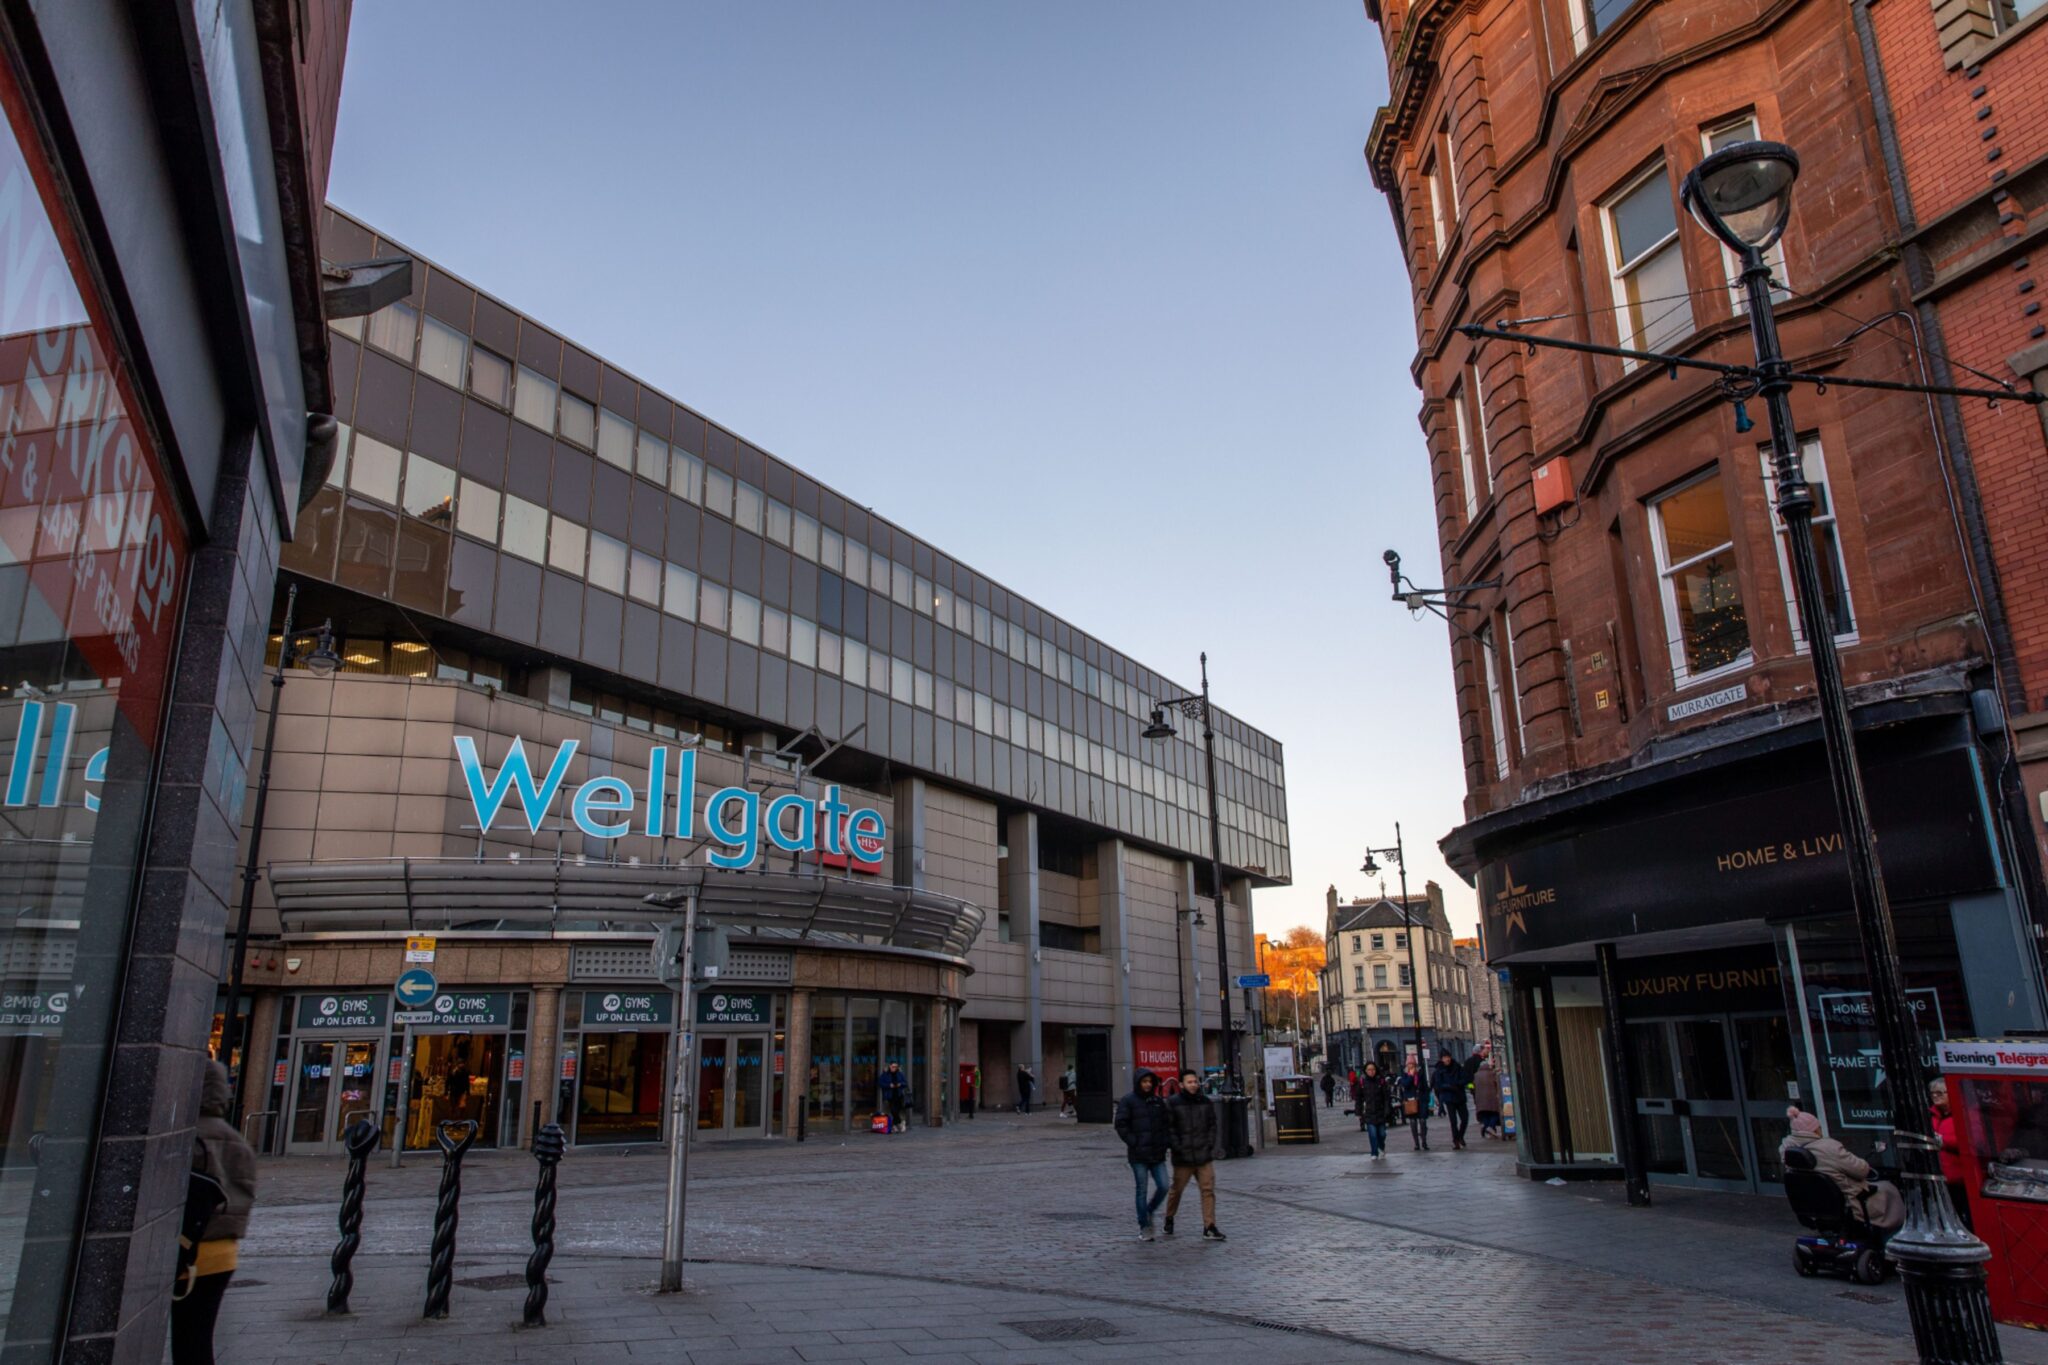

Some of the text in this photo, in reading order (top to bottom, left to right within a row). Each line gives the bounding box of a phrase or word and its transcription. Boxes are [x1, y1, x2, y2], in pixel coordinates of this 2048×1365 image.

[94, 568, 141, 675] REPAIRS
[1670, 687, 1745, 719] MURRAYGATE
[453, 734, 887, 870] Wellgate
[1716, 846, 1778, 872] HOME
[1783, 842, 1798, 860] &
[1502, 888, 1555, 912] FURNITURE
[1622, 976, 1690, 996] UXURY
[342, 999, 368, 1012] GYMS
[459, 998, 486, 1010] GYMS
[625, 997, 650, 1009] GYMS
[731, 998, 753, 1009] GYMS
[1832, 1002, 1870, 1014] HOME
[313, 1016, 375, 1026] UP ON LEVEL 3
[434, 1014, 495, 1024] P ON LEVEL 3
[596, 1013, 659, 1022] UP ON LEVEL 3
[706, 1013, 760, 1022] UP ON LEVEL 3
[1149, 1051, 1177, 1064] HUGHES
[1829, 1056, 1867, 1068] FAME
[1944, 1051, 1997, 1066] Evening
[1851, 1109, 1888, 1119] LUXURY
